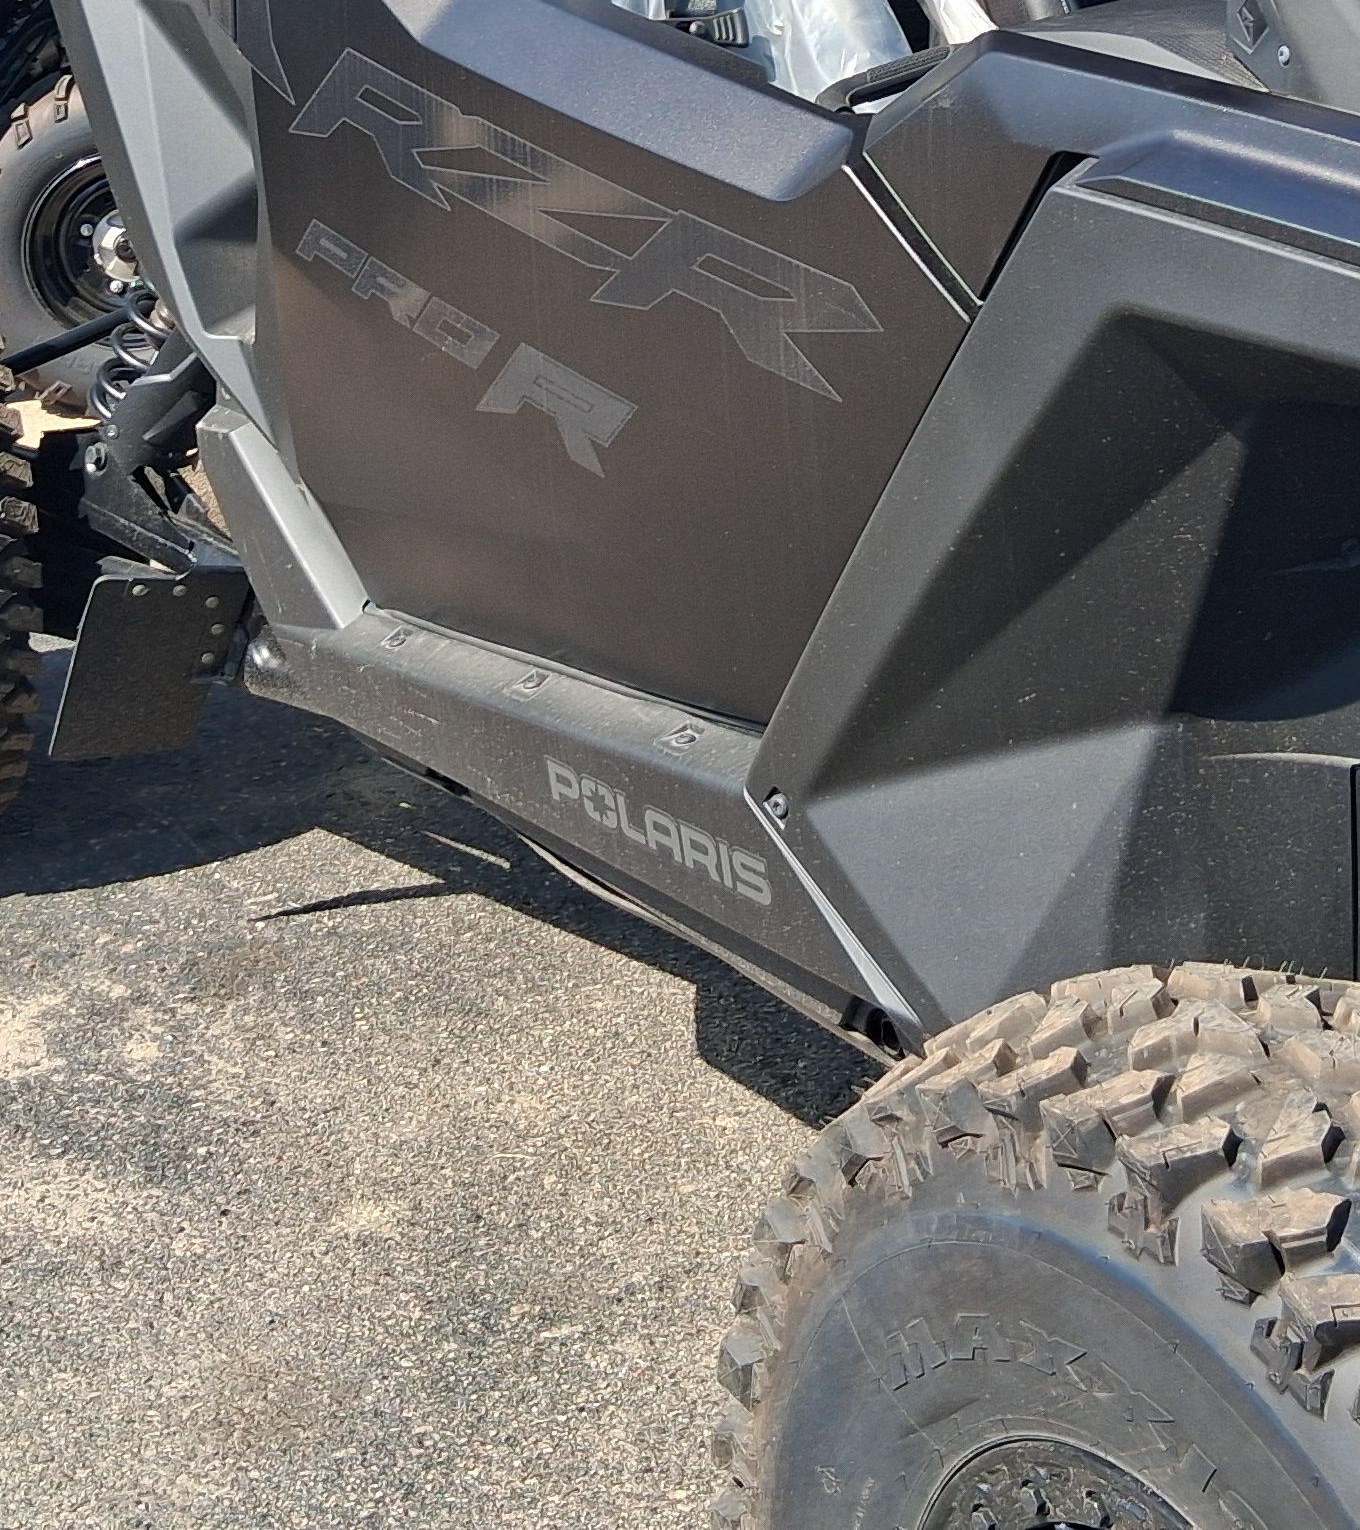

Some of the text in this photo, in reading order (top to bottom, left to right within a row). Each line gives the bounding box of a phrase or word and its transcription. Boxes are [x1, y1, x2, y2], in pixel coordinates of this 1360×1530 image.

[288, 46, 885, 404] RZR
[294, 218, 639, 480] PRO R
[544, 754, 774, 907] POLARIS
